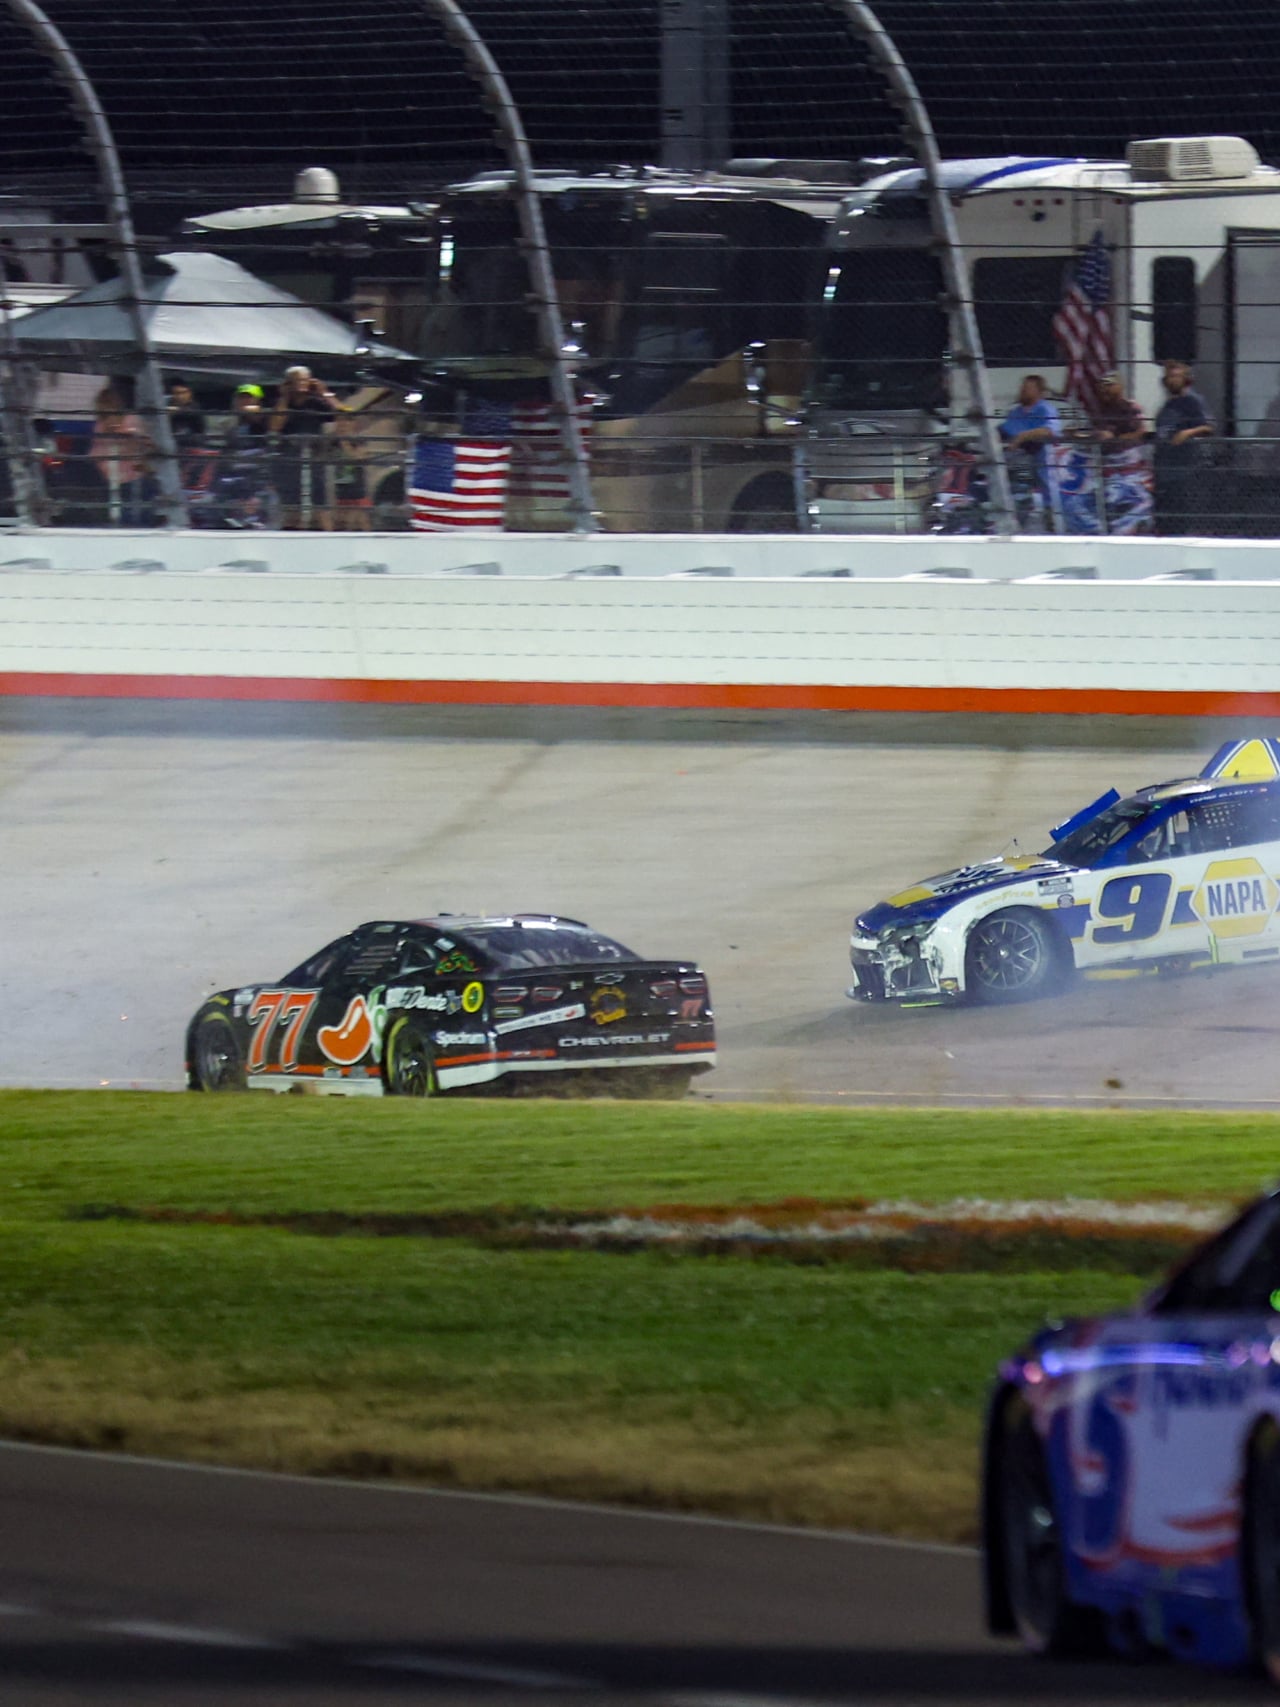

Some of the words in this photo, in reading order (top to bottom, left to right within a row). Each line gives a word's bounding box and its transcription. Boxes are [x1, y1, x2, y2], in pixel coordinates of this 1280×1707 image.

[1091, 872, 1173, 945] 9
[1207, 879, 1267, 917] NAPA
[247, 987, 323, 1073] 77
[557, 1032, 672, 1048] CHEVROLET
